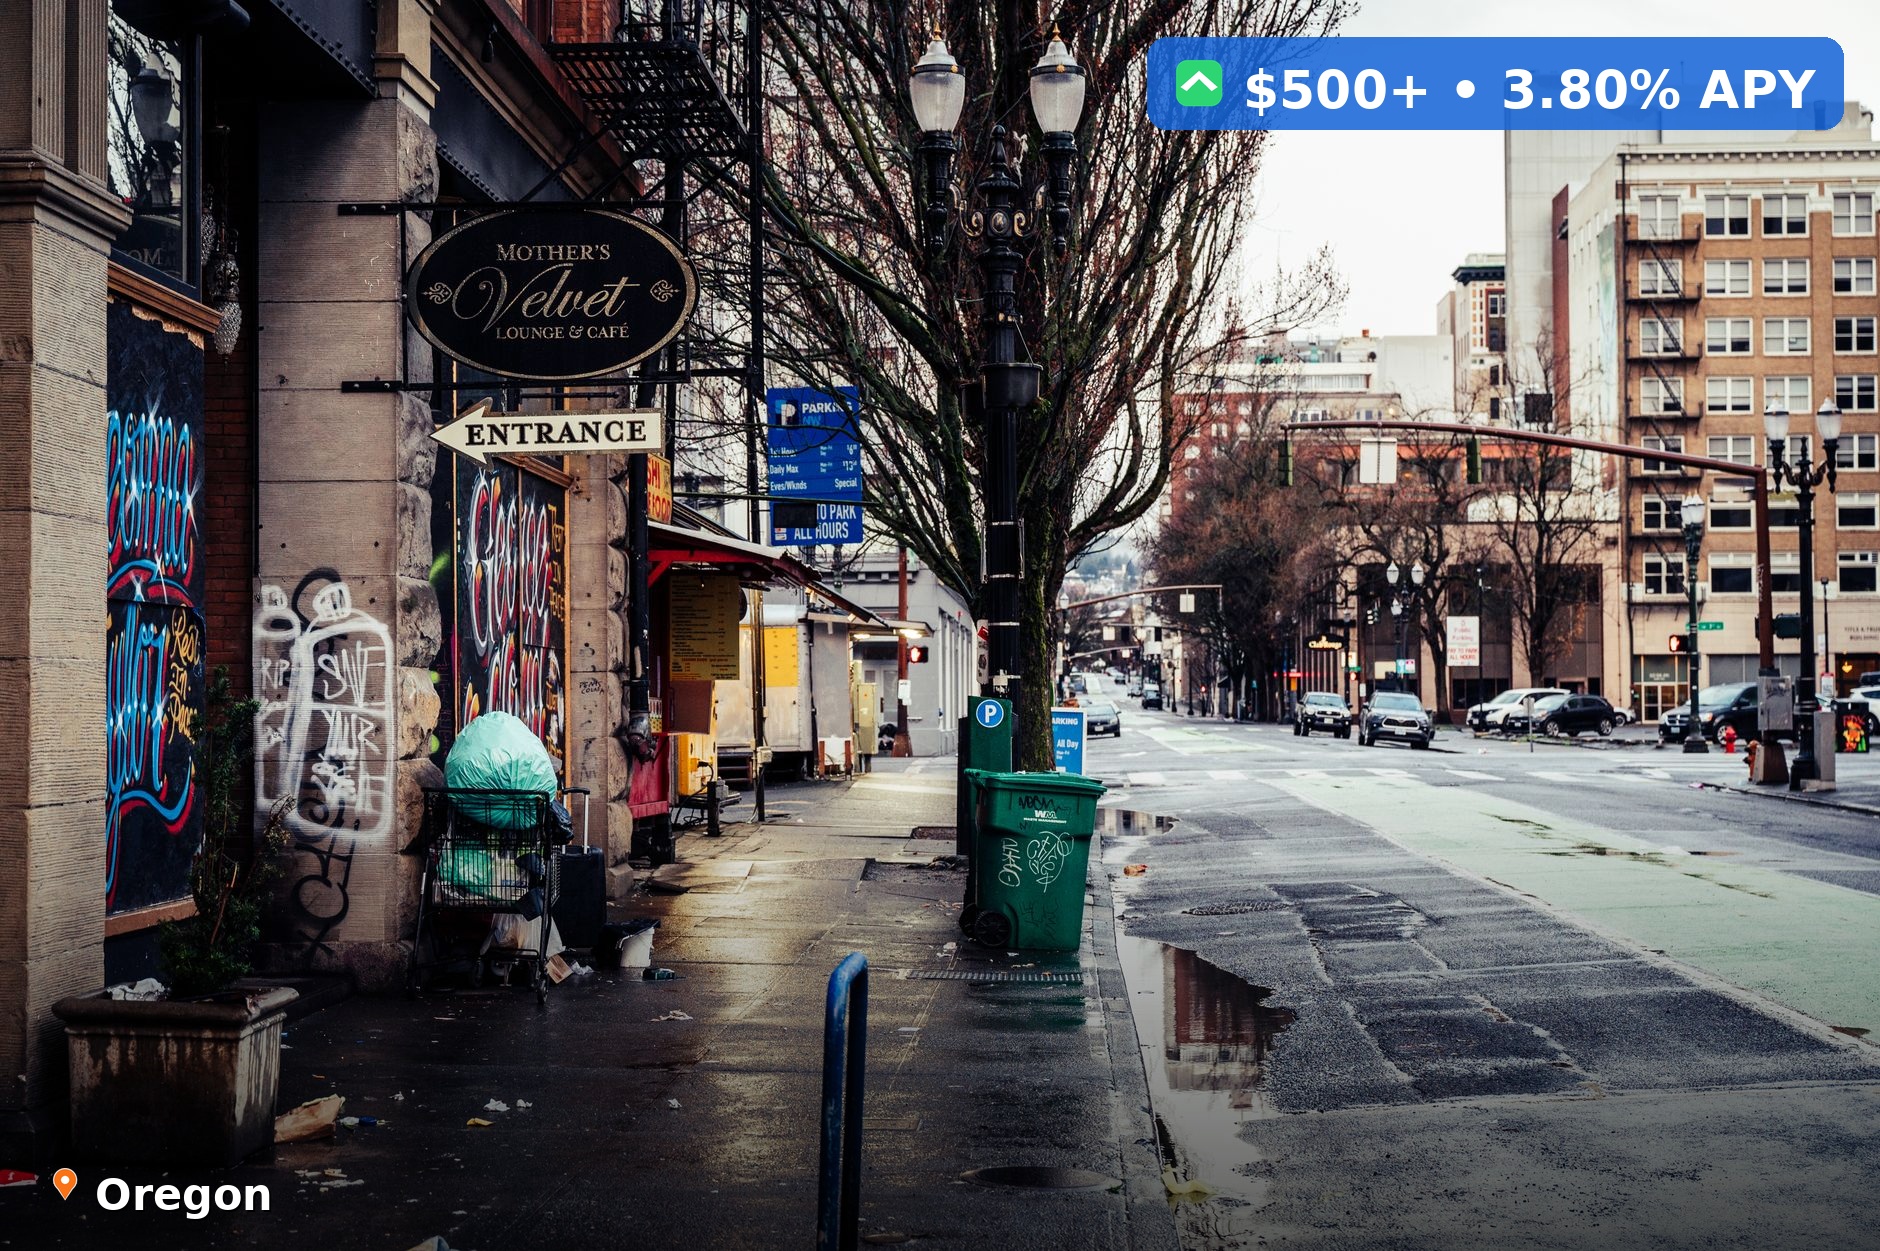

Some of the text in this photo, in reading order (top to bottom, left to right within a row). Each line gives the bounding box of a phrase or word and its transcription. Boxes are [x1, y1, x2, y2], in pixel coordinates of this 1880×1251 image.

[497, 244, 610, 261] MOTHER'S
[452, 263, 640, 333] Velvet
[497, 323, 629, 340] LOUNGE & CAFÉ
[465, 420, 646, 446] ENTRANCE
[770, 463, 799, 475] Daily Max
[770, 481, 807, 491] Eves/Wknds
[835, 478, 857, 490] Special
[830, 504, 857, 520] PARK
[815, 522, 849, 539] HOURS
[1057, 739, 1079, 750] All Day
